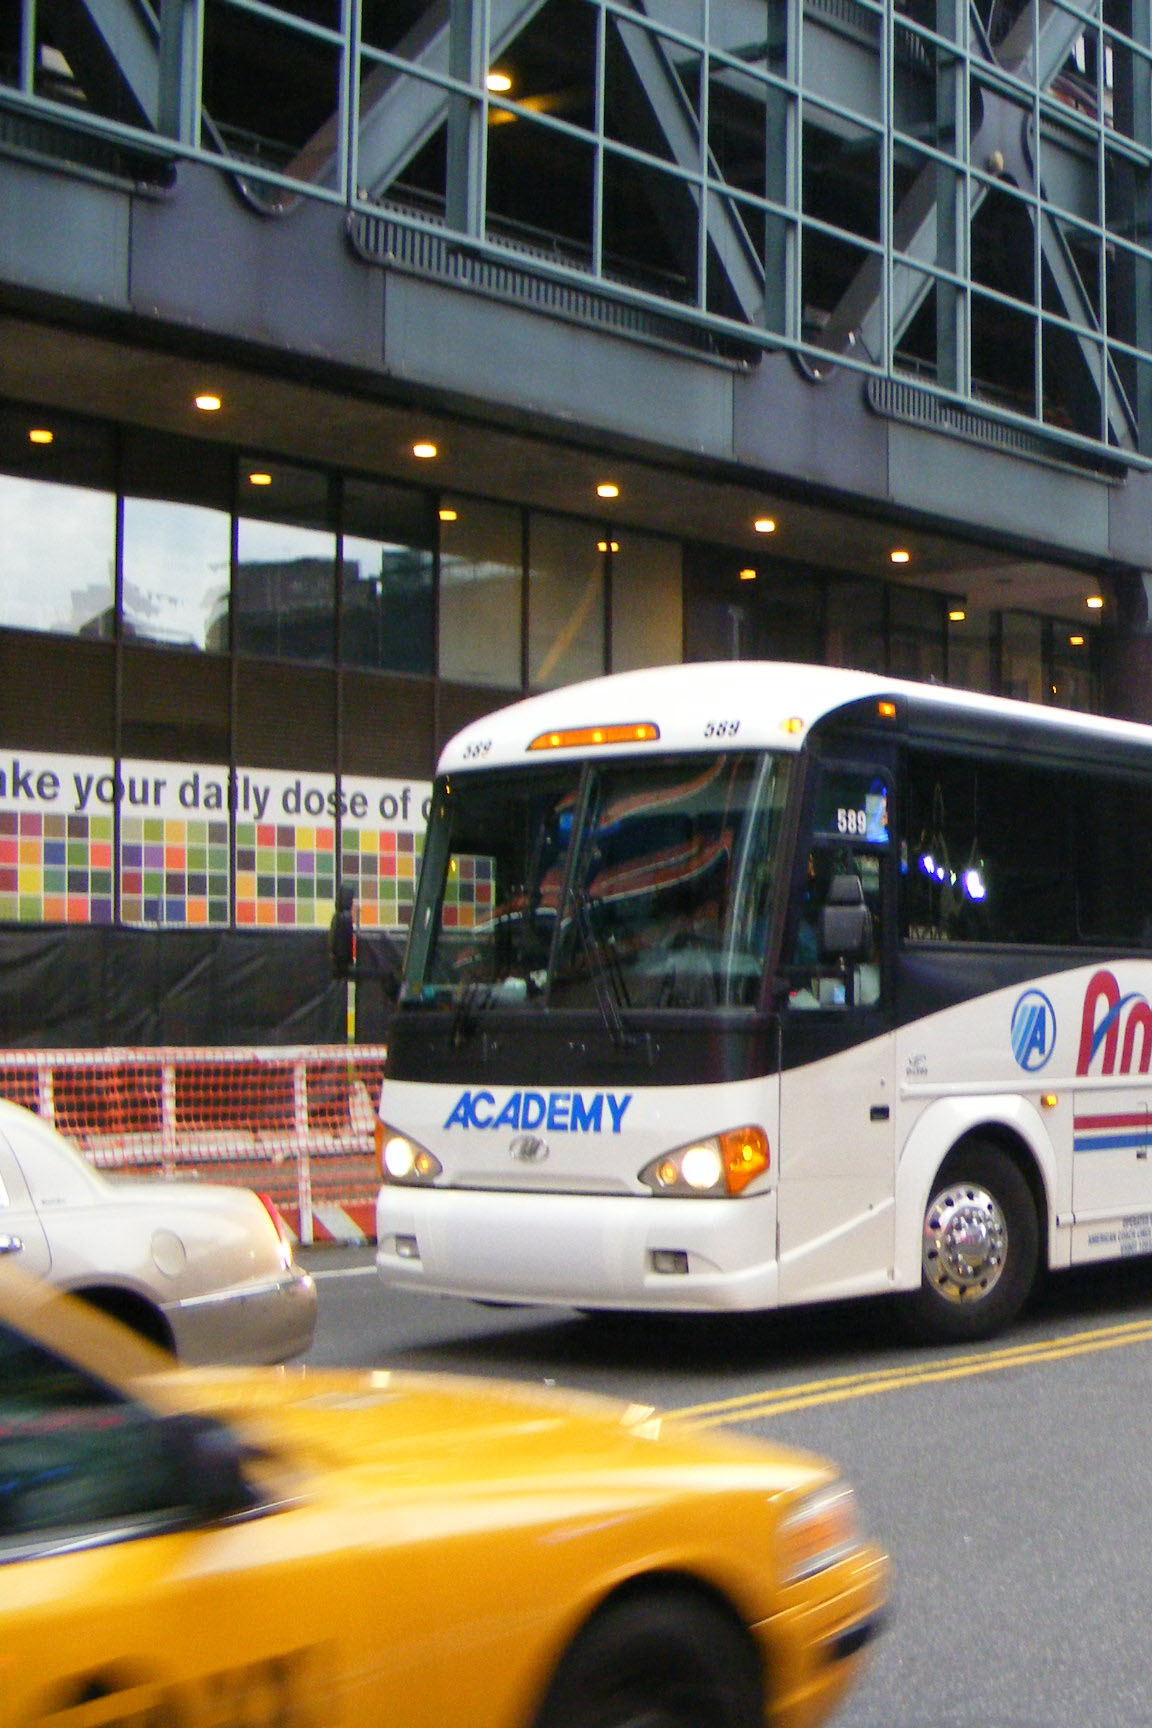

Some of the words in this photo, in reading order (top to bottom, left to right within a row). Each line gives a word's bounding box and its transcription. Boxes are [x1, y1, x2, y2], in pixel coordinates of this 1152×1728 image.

[703, 721, 740, 738] 589
[73, 772, 167, 811] your
[282, 779, 369, 818] dose
[379, 786, 412, 820] of
[837, 808, 867, 834] 589
[443, 1090, 633, 1134] ACADEMY
